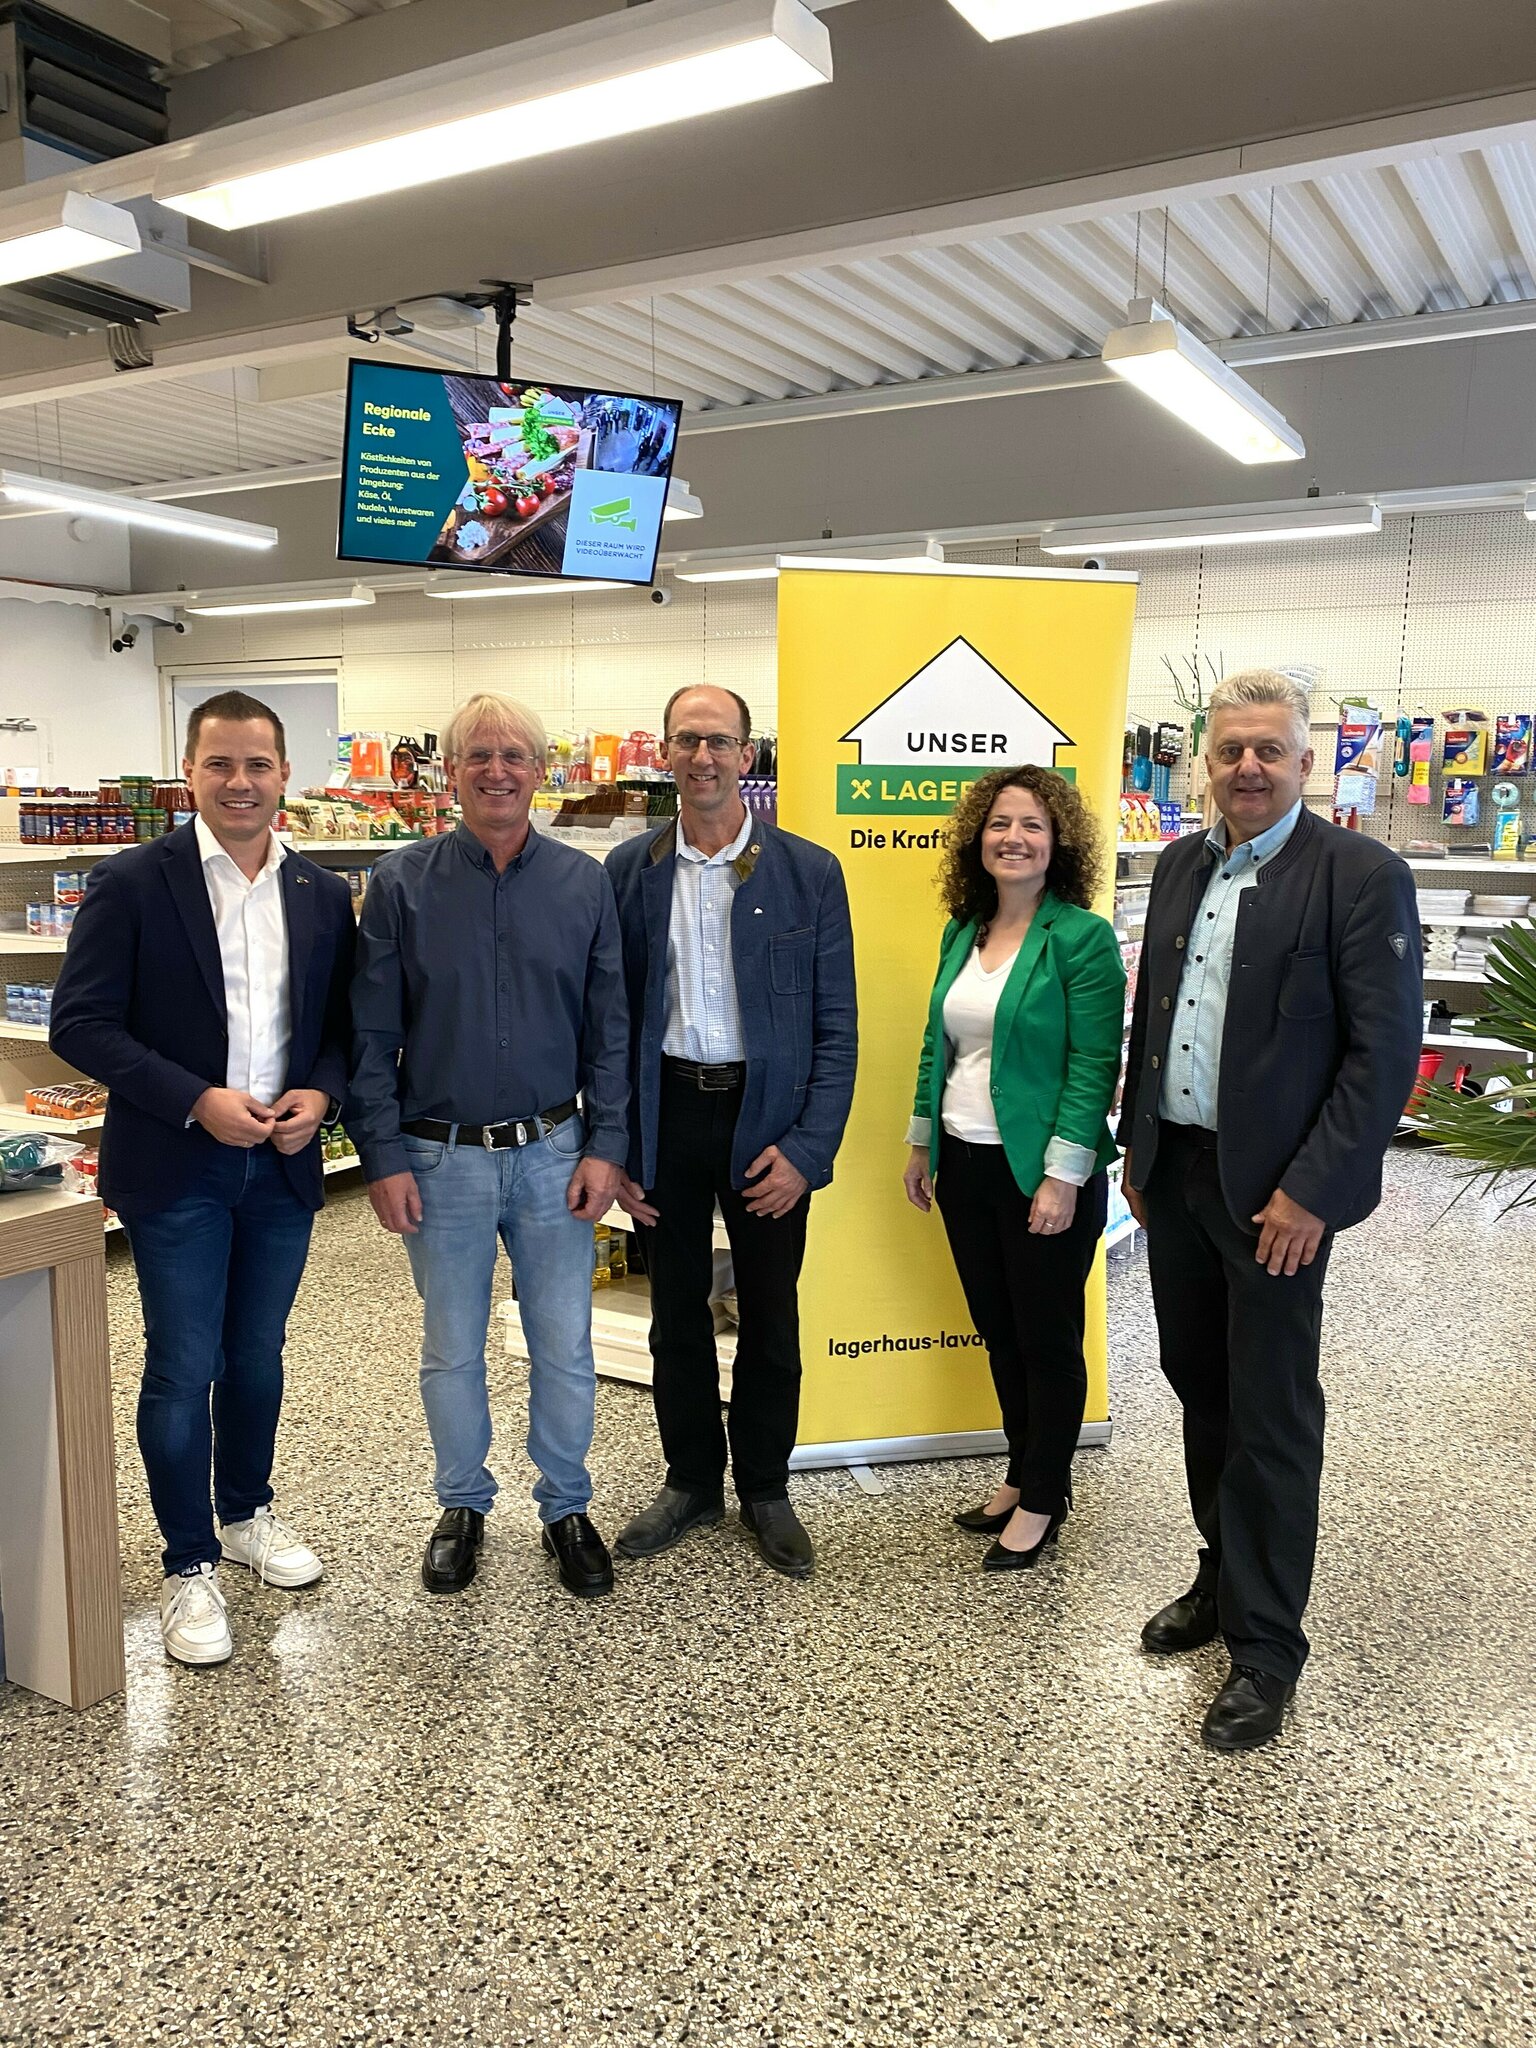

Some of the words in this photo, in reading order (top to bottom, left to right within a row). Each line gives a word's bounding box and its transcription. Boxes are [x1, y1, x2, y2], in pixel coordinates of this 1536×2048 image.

[364, 402, 431, 421] Regionale
[362, 422, 396, 437] Ecke
[360, 452, 416, 465] Köstlichkeiten
[416, 459, 432, 467] von
[359, 464, 410, 477] Produzenten
[410, 470, 425, 479] aus
[426, 472, 440, 480] der
[359, 477, 404, 490] Umgebung:
[358, 490, 380, 500] Käse,
[357, 502, 387, 513] Nudeln,
[388, 505, 434, 517] Wurstwaren
[356, 515, 372, 523] und
[373, 517, 396, 526] vieles
[396, 519, 417, 528] mehr
[576, 540, 602, 548] DIESER
[603, 542, 624, 550] RAUM
[625, 544, 646, 552] WIRD
[576, 548, 644, 560] VIDEOÜBERWACHT
[907, 732, 1008, 754] UNSER
[851, 829, 886, 849] Die
